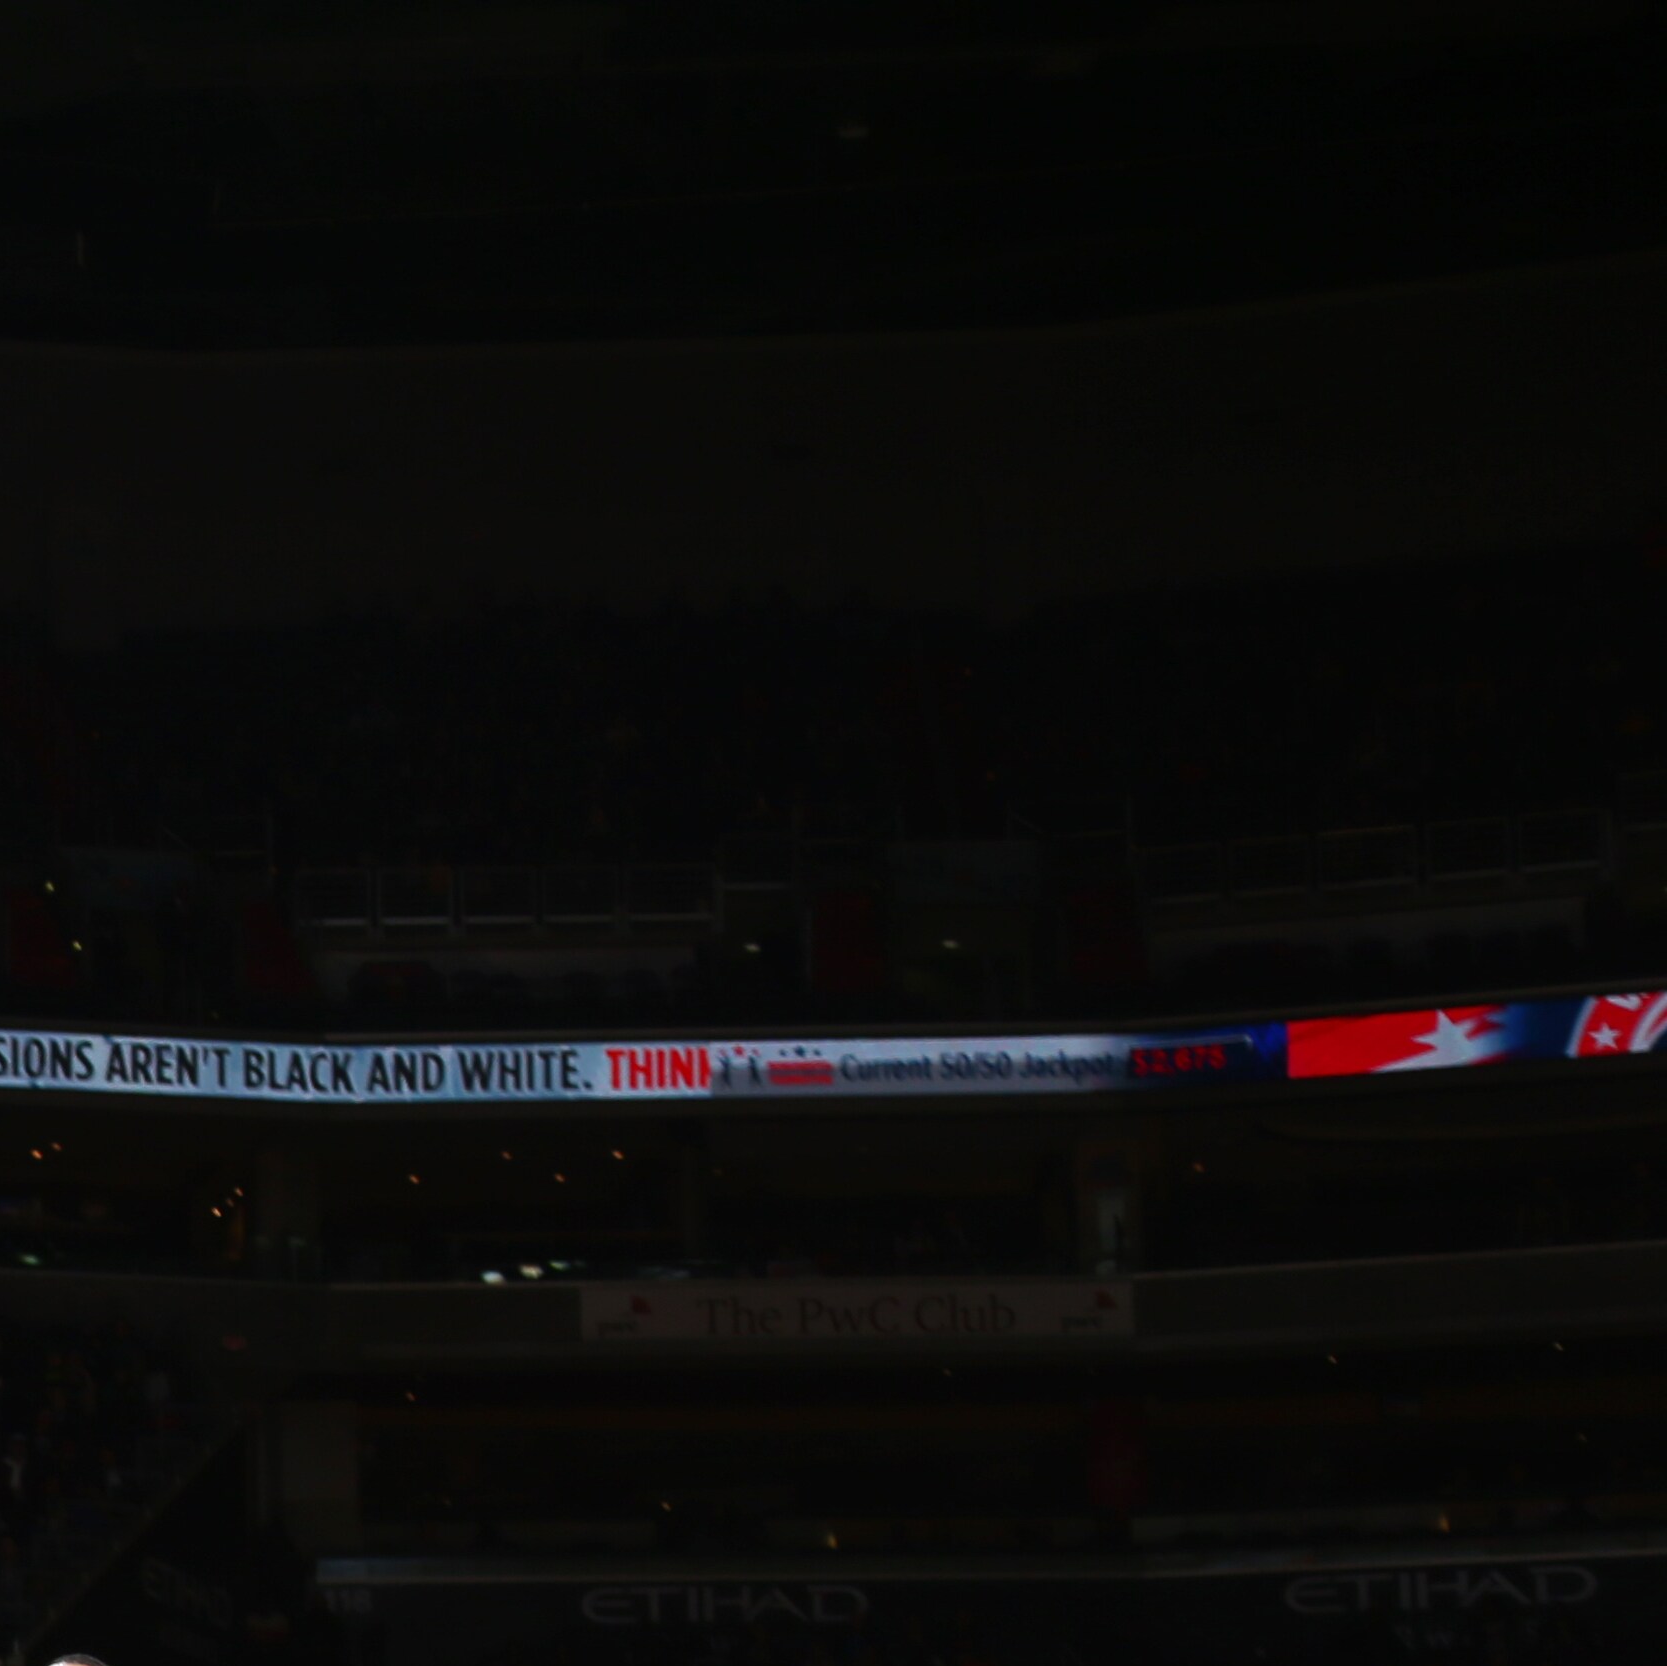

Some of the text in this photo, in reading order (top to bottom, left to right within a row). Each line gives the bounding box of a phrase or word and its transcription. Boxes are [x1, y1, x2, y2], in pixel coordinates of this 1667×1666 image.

[105, 1041, 231, 1088] AREN'T
[243, 1047, 356, 1094] BLACK
[368, 1049, 445, 1093] AND
[456, 1049, 593, 1093] WHITE.
[840, 1048, 1115, 1085] Current 50/50 Jackpot
[697, 1293, 1016, 1335] The PwC Club
[582, 1584, 869, 1625] ETIHAD
[1283, 1564, 1598, 1614] ETIHAD
